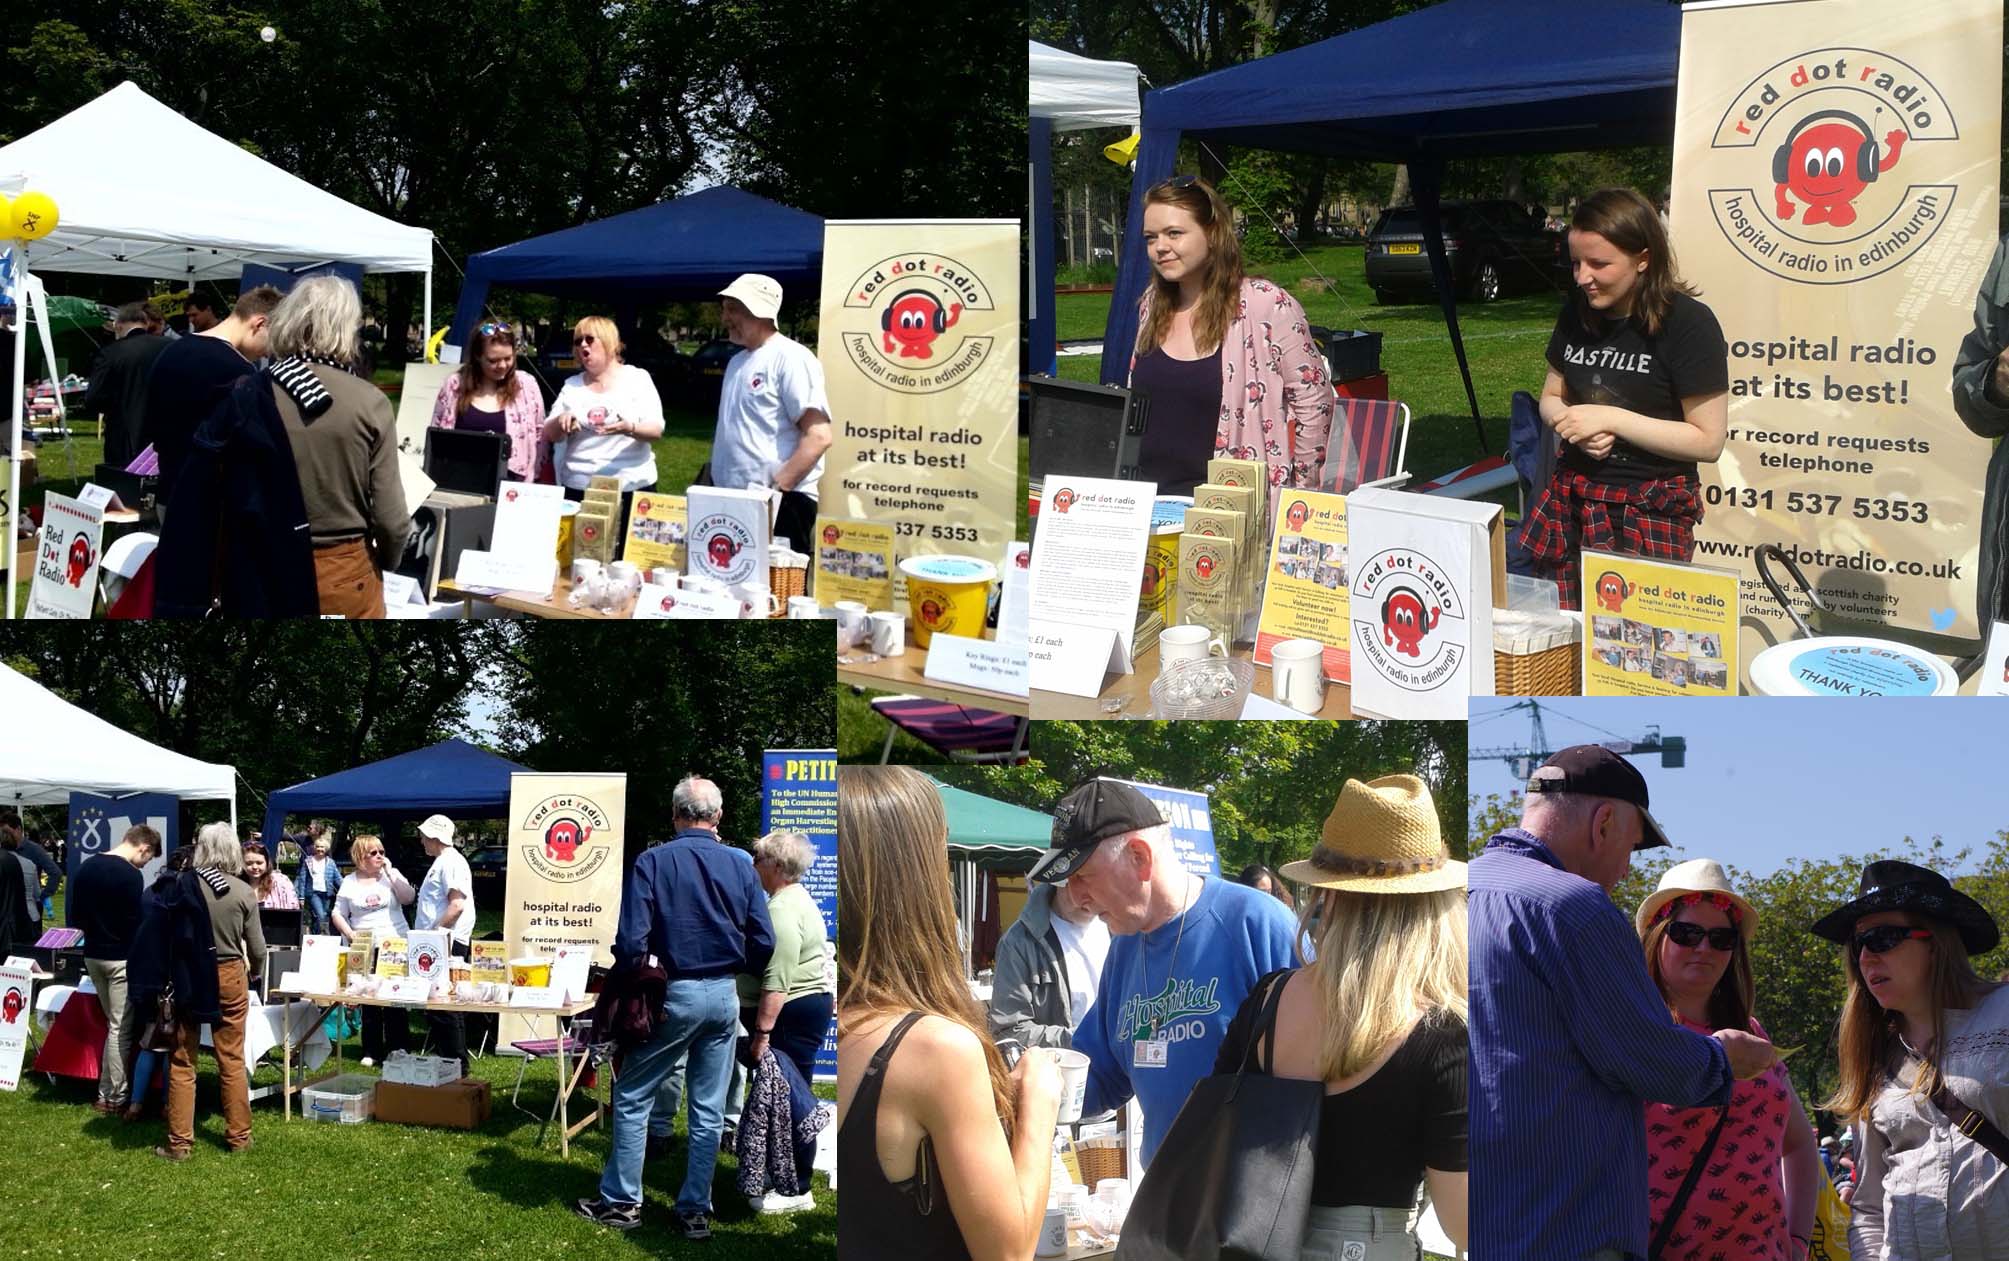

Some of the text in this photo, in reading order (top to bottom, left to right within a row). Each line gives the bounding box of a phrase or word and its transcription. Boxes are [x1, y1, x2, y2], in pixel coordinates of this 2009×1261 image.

[1736, 58, 1932, 135] red dot radio
[1725, 194, 1938, 273] hospital radio in edinburgh
[857, 259, 978, 303] red dot radio
[1563, 344, 1652, 374] BASTILLE
[1726, 336, 1937, 366] ospital radio
[852, 337, 983, 388] hospital radio in edinburgh
[1731, 374, 1909, 405] at its best!
[845, 421, 983, 446] hospital radio
[1745, 429, 1819, 447] record
[1827, 435, 1930, 454] requests
[857, 448, 966, 469] at its best!
[1760, 452, 1874, 474] telephone
[842, 479, 979, 500] for record requests
[1082, 494, 1136, 505] red dot radio
[874, 497, 945, 512] telephone
[1315, 509, 1331, 519] red
[1705, 485, 1928, 524] 0131 537 5353
[46, 524, 64, 545] Red
[931, 525, 978, 542] 5353
[43, 543, 60, 563] Dot
[1695, 540, 1962, 580] ww.rddotradio.co.uk
[39, 561, 66, 586] Radio
[1363, 564, 1383, 592] red
[1387, 555, 1413, 569] dot
[1418, 563, 1452, 609] radio
[1638, 585, 1725, 607] red dot radio
[1740, 580, 1790, 592] egisted
[1818, 588, 1859, 600] scottish
[1862, 592, 1900, 606] charity
[1293, 600, 1320, 610] Volunteer
[1665, 601, 1681, 609] radio
[1692, 606, 1725, 617] edinburgh
[1745, 604, 1784, 619] (charity
[1824, 601, 1837, 612] by
[1840, 603, 1897, 617] volunteers
[1296, 613, 1329, 624] Interested?
[1046, 637, 1063, 647] each
[1034, 652, 1052, 661] each
[1362, 627, 1386, 666] hospital
[1386, 665, 1408, 683] radio
[1411, 675, 1419, 685] in
[1421, 649, 1456, 685] edinburgh
[1830, 647, 1932, 682] red dot radio
[1799, 668, 1856, 694] THANK
[786, 760, 837, 781] PETIT
[771, 789, 782, 797] To
[783, 789, 797, 797] the
[798, 789, 810, 797] UN
[771, 799, 790, 807] High
[531, 799, 602, 827] red dot radio
[770, 817, 794, 826] Organ
[783, 808, 825, 816] Immediate
[547, 870, 565, 879] radio
[575, 850, 603, 877] edinburgh
[523, 901, 602, 914] hospital radio
[530, 916, 593, 927] at its best!
[535, 936, 562, 944] record
[564, 937, 600, 945] requests
[1119, 976, 1220, 1041] Hospital
[1157, 1020, 1206, 1043] RADIO
